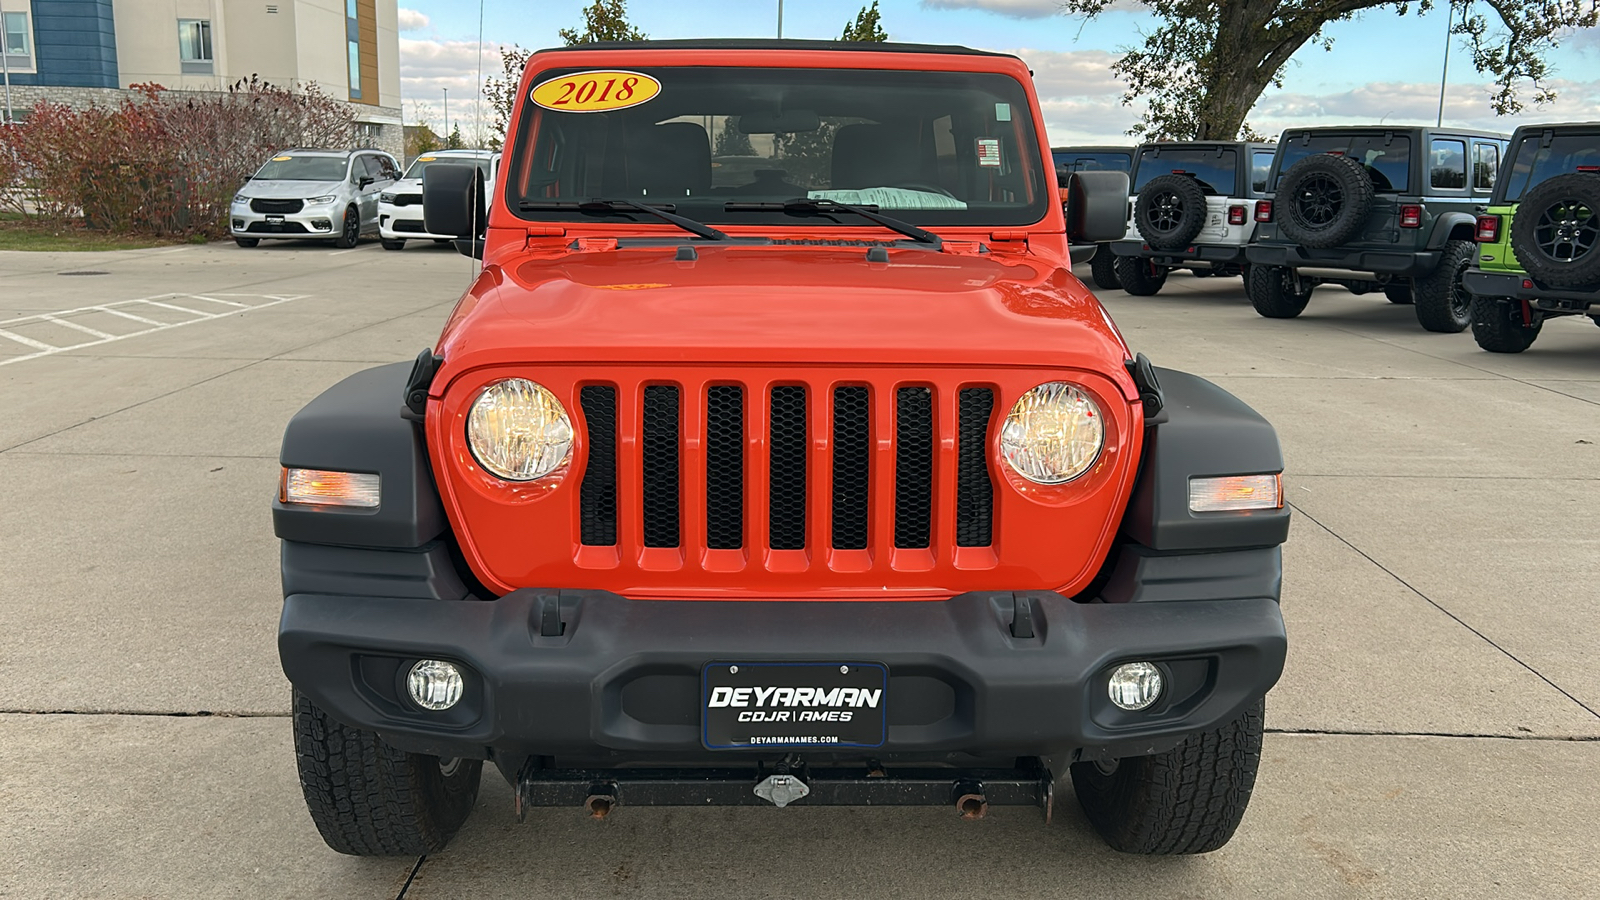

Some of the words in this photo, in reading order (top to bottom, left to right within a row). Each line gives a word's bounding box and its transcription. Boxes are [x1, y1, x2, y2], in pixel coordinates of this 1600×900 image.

[552, 77, 639, 105] 2018
[708, 686, 882, 708] DEYARMAN
[737, 711, 790, 722] CDJR
[799, 711, 853, 722] AMES
[750, 736, 839, 744] DEYARMANAMES.COM
